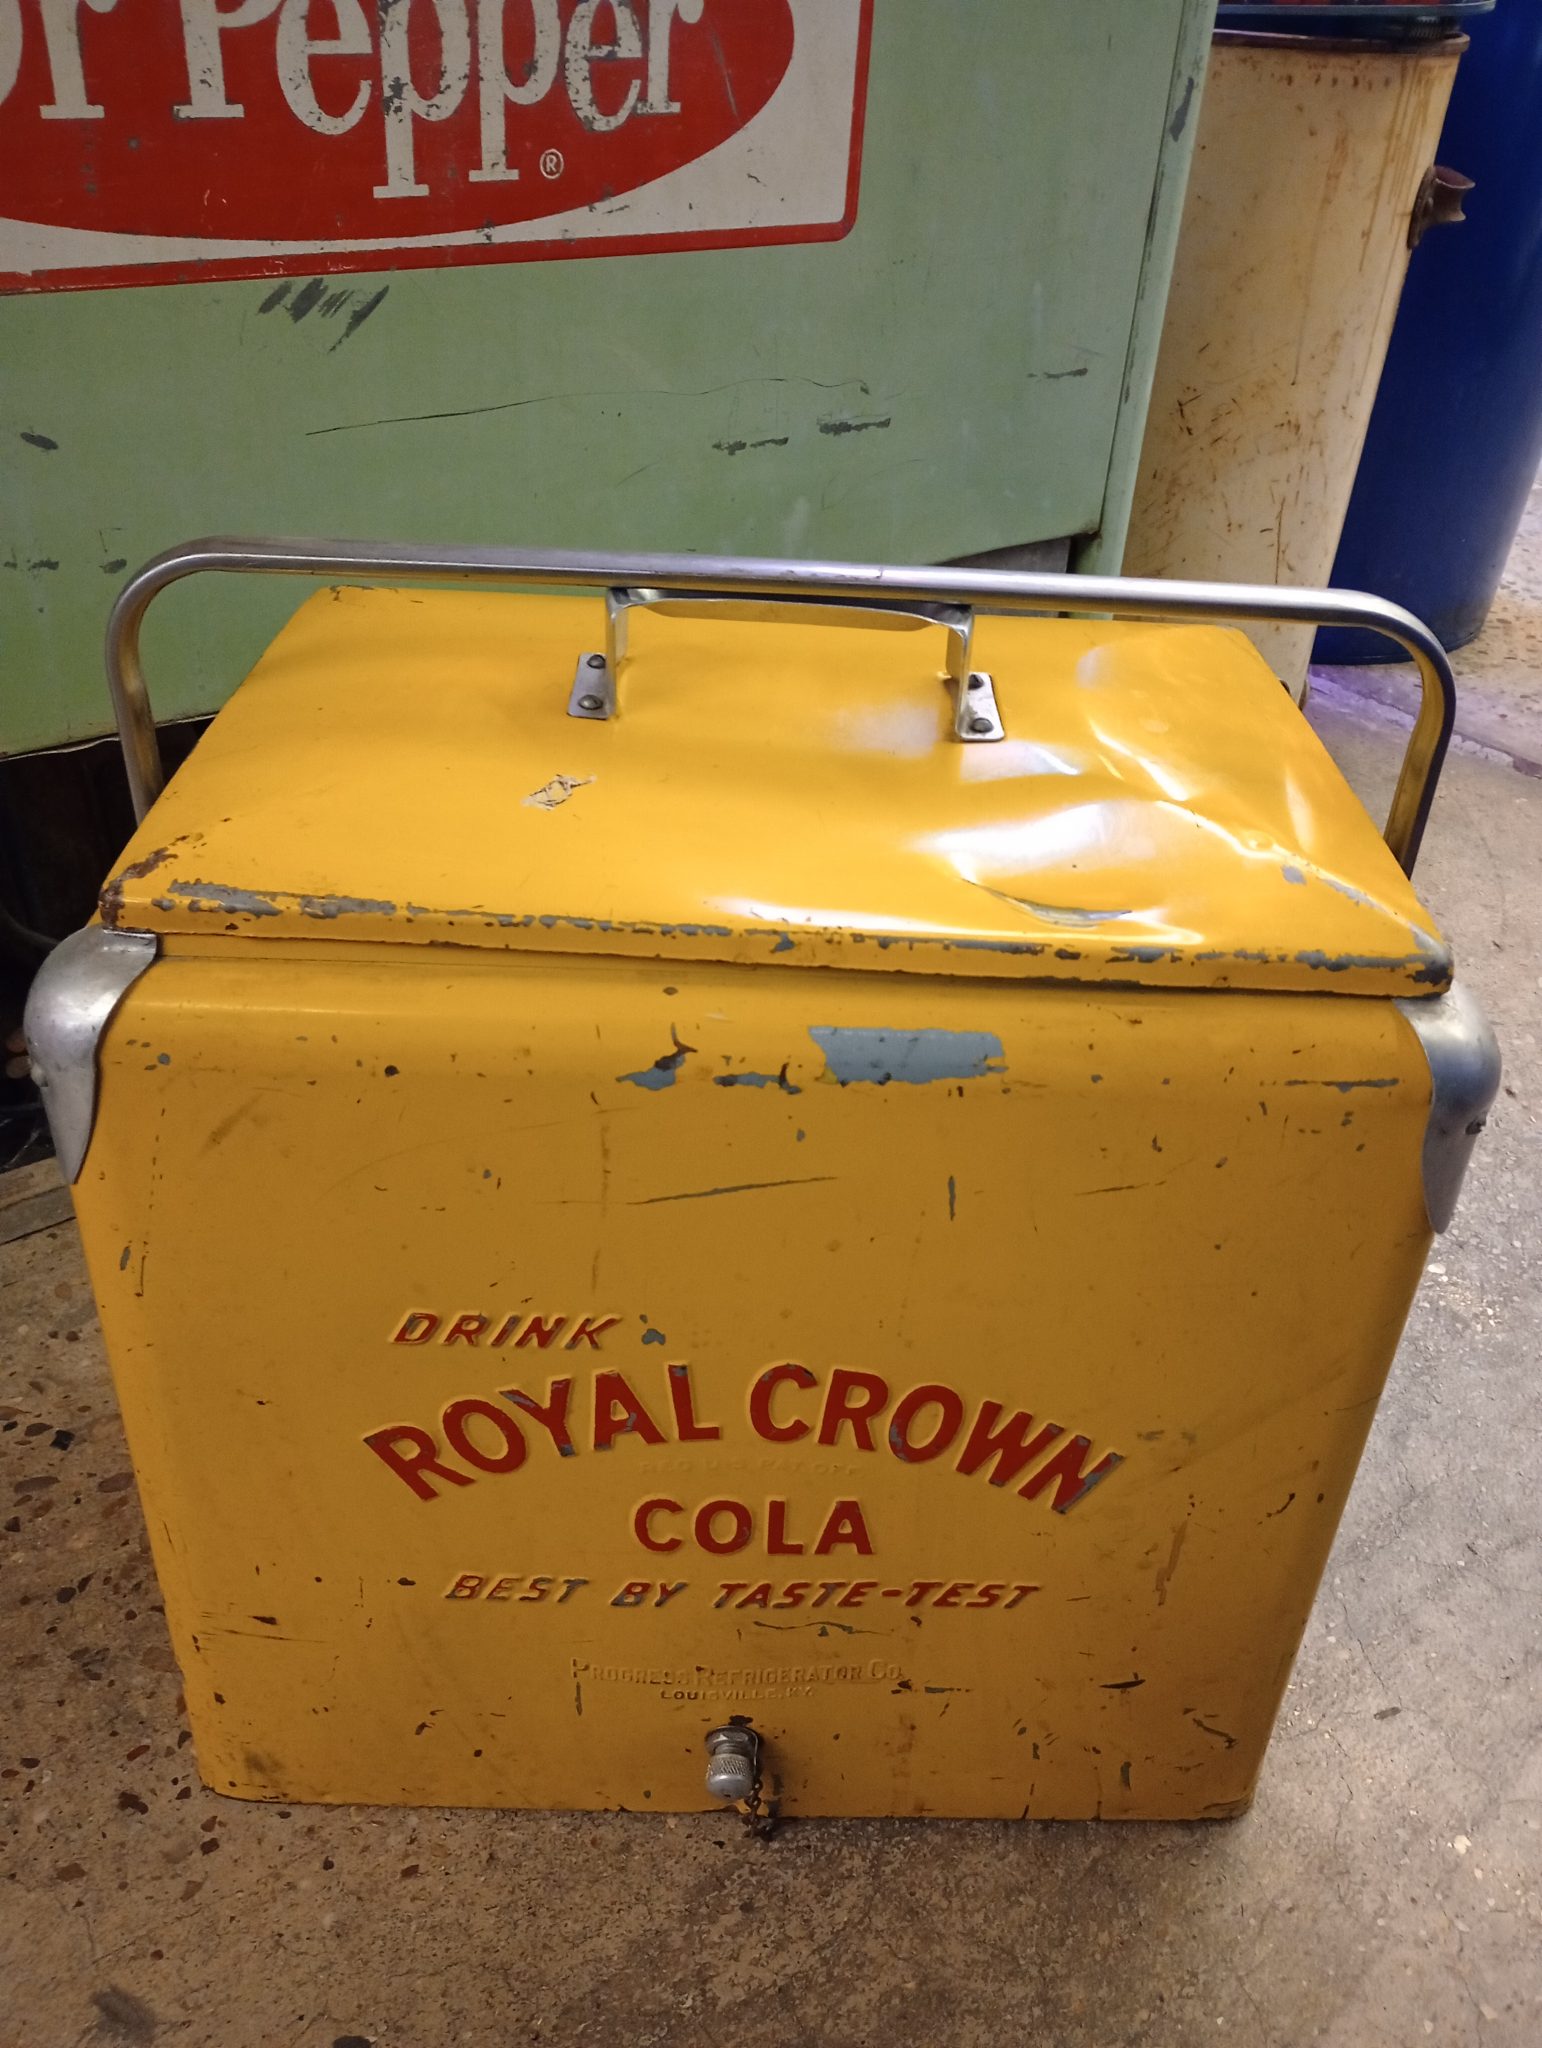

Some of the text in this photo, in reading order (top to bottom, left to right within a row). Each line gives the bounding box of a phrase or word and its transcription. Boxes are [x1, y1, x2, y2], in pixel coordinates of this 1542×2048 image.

[173, 0, 706, 198] Pepper
[391, 1312, 620, 1349] DRINK
[363, 1363, 1125, 1514] ROYAL CROWN
[634, 1499, 873, 1555] COLA
[444, 1575, 1040, 1609] BEST BY TASTE-TEST
